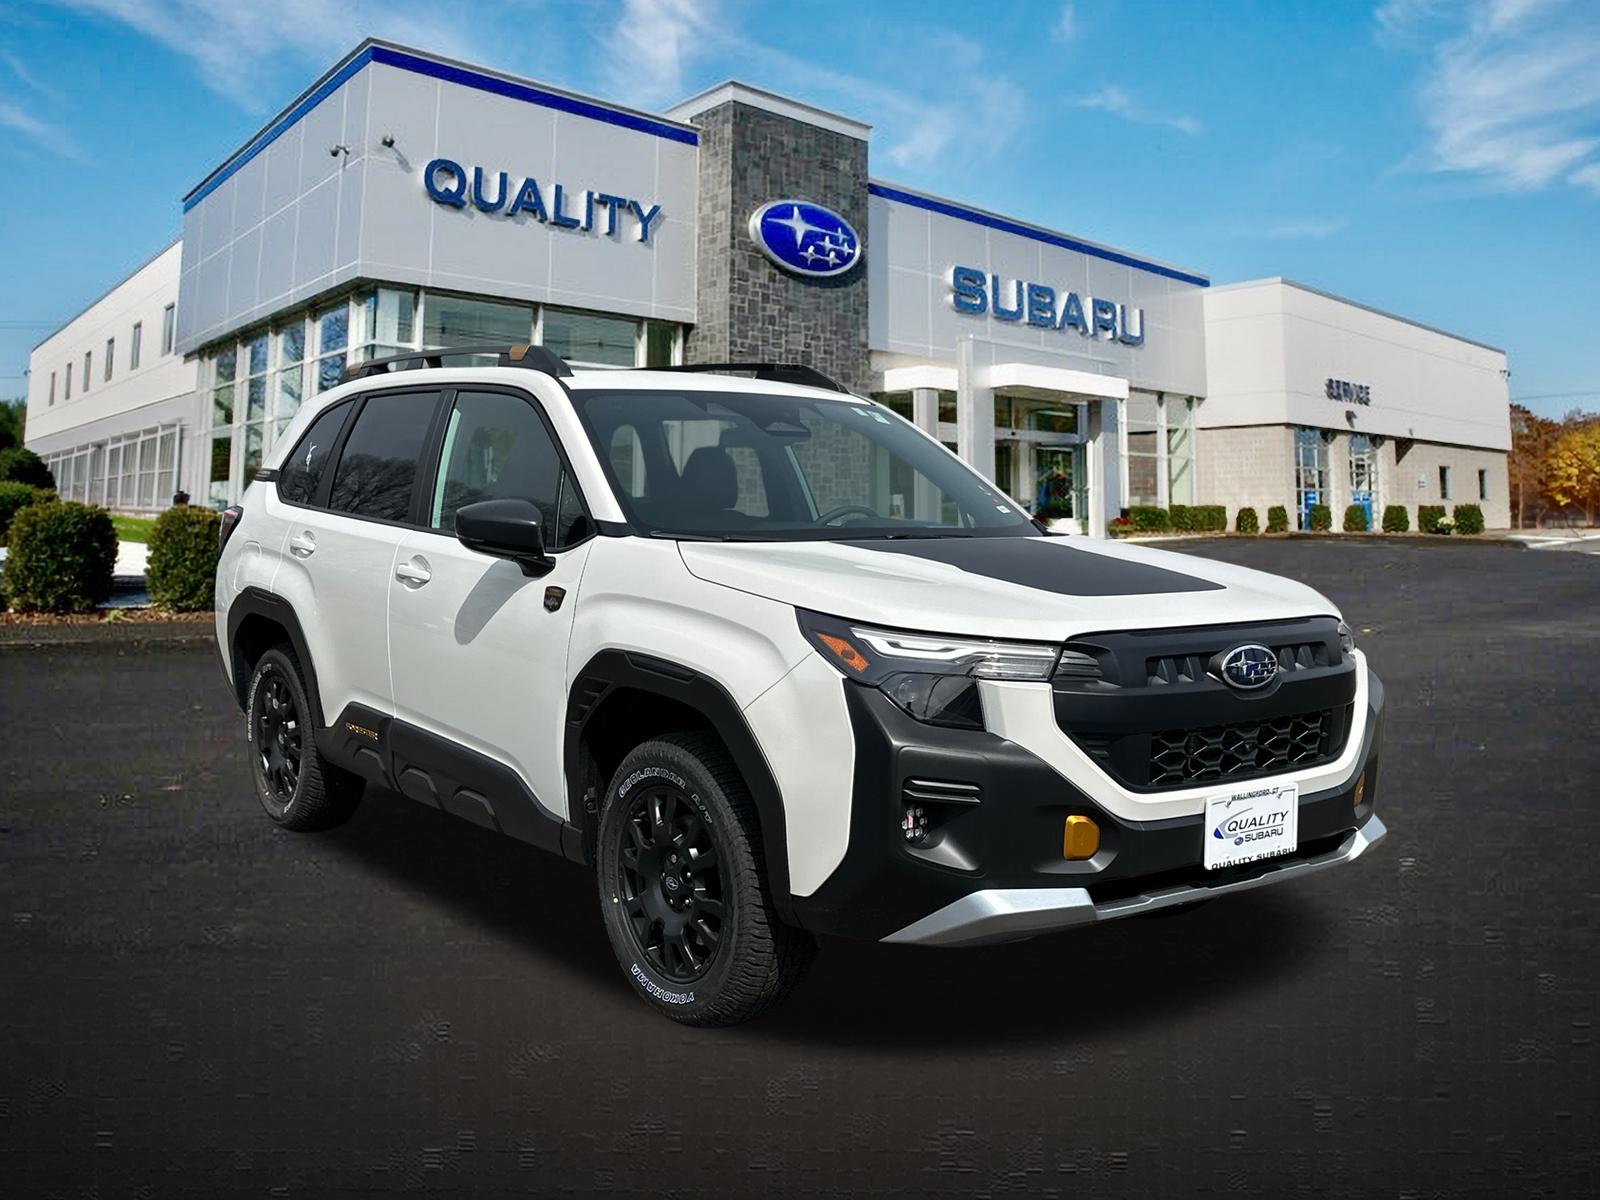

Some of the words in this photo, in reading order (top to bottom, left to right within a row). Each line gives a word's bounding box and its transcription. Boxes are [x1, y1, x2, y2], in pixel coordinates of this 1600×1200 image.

[424, 158, 661, 243] QUALITY
[951, 265, 1145, 346] SUBARU
[1227, 810, 1289, 832] QUALITY
[1244, 827, 1284, 842] SUBARU
[1211, 856, 1253, 870] QUALITY
[1256, 846, 1295, 860] SUBARU
[630, 963, 695, 1004] YOKOHAMA
